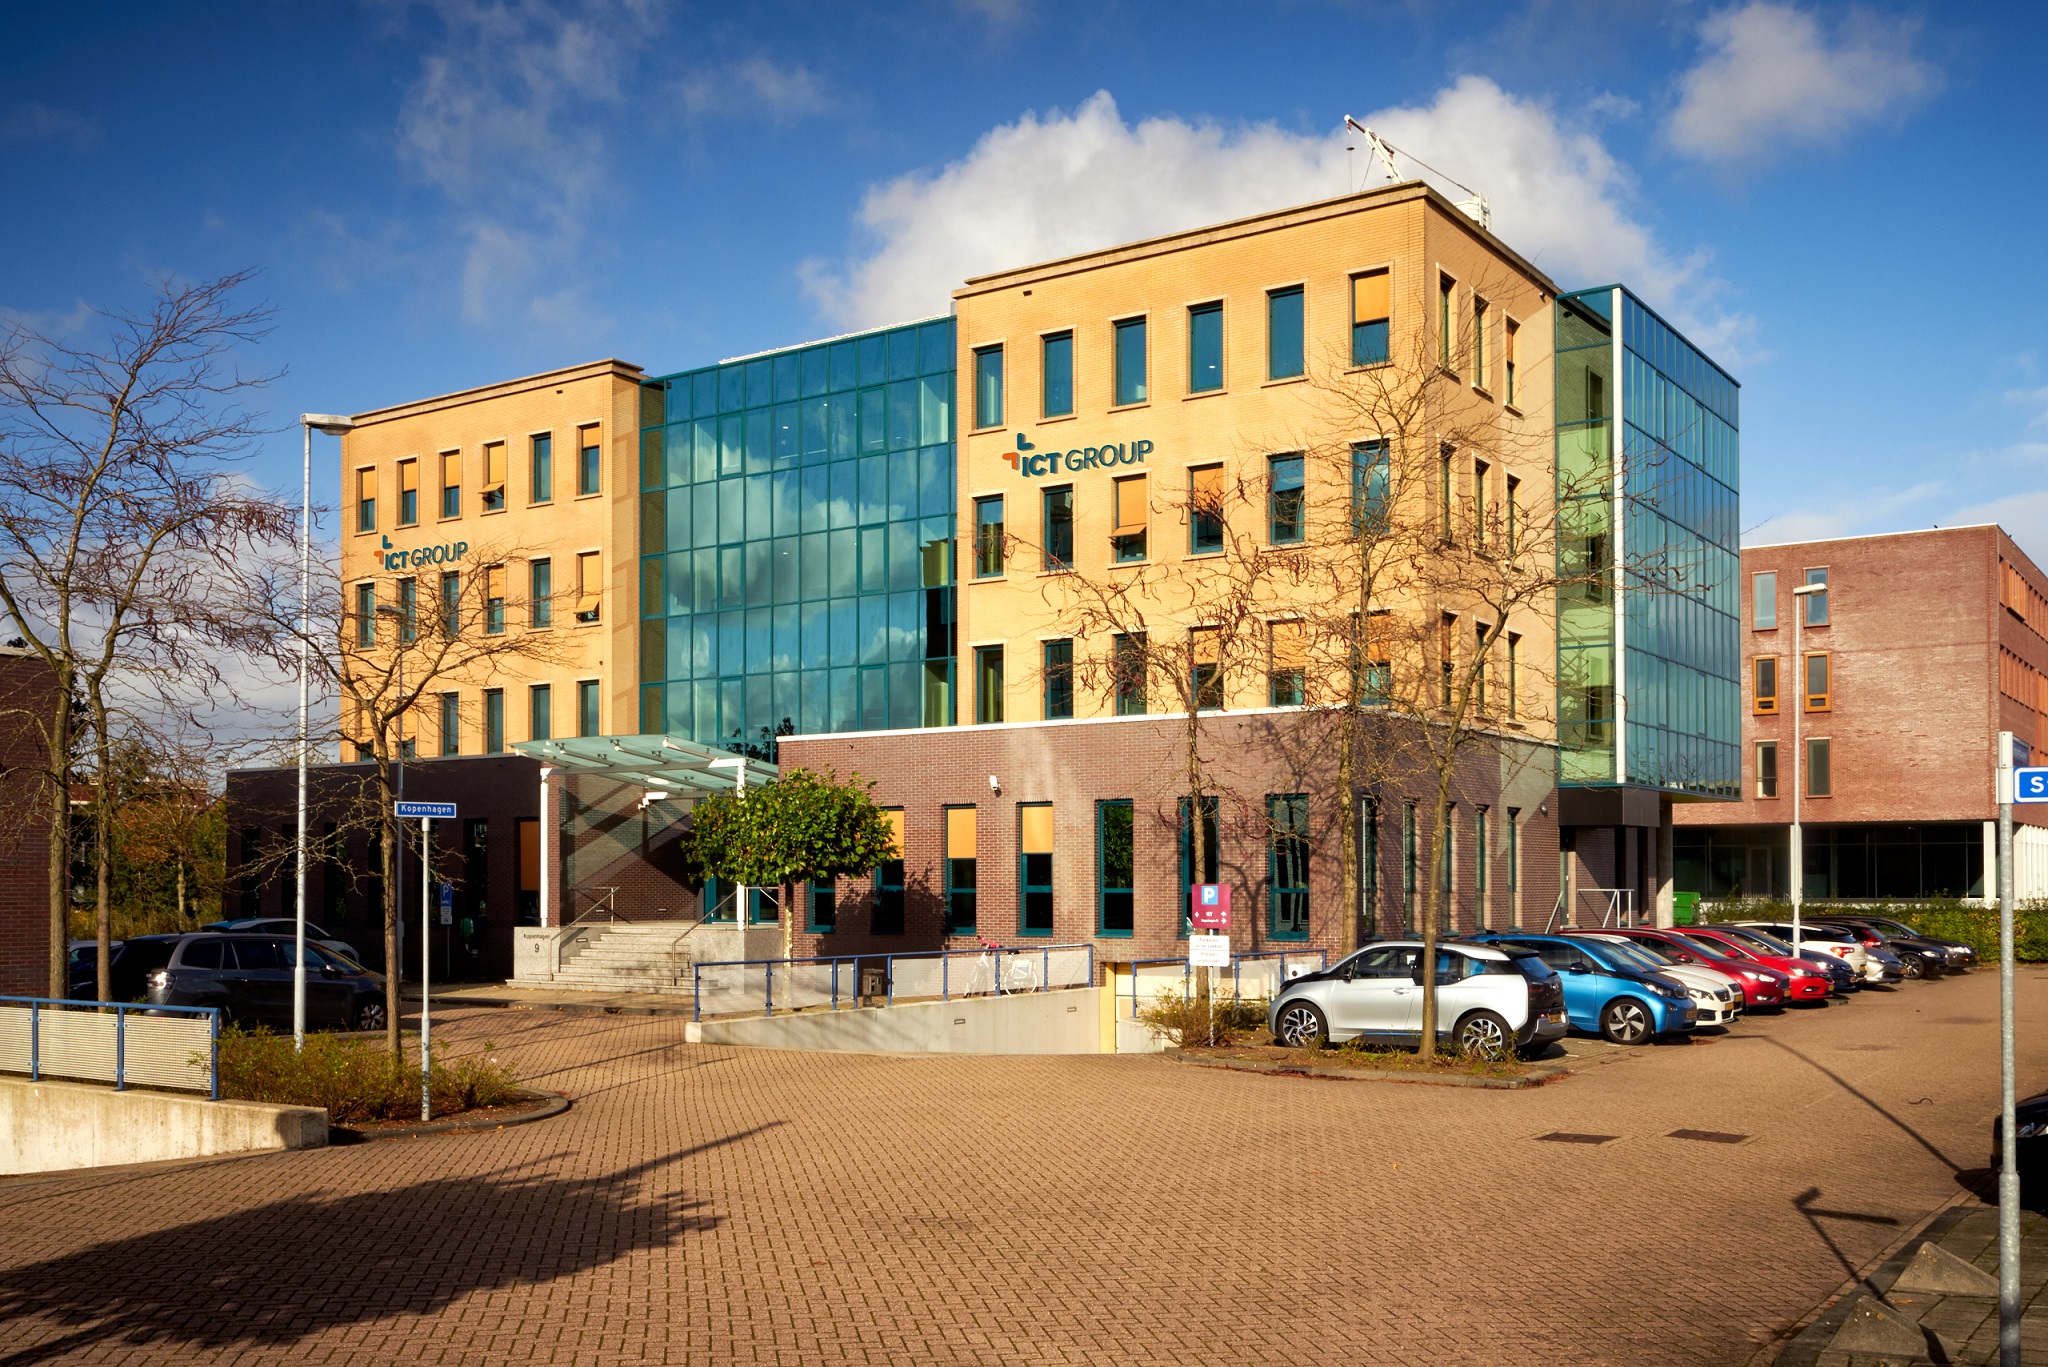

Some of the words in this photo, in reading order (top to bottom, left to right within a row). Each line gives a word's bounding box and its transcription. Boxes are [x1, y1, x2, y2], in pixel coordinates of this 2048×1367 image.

[1022, 452, 1062, 478] ICT
[1065, 439, 1154, 472] GROUP
[385, 551, 410, 571] ICT
[411, 541, 468, 567] GROUP
[2030, 776, 2048, 793] S
[401, 804, 452, 815] Kopenhagen
[1204, 887, 1215, 904] P
[523, 933, 551, 941] Kopenhagen
[534, 943, 540, 953] 9
